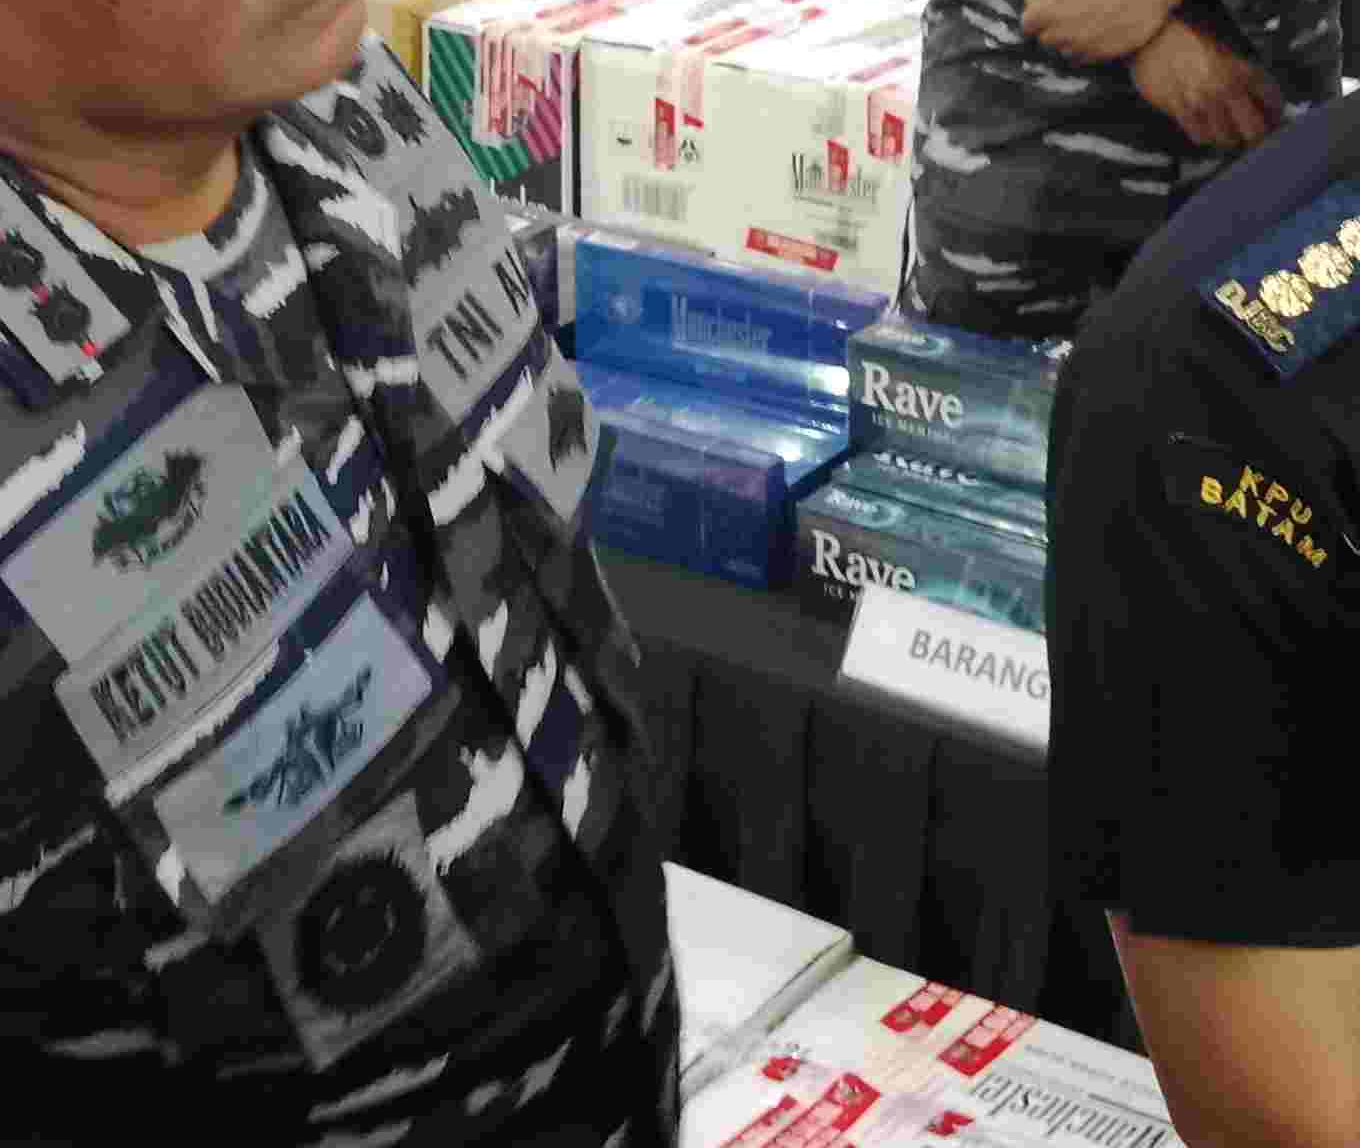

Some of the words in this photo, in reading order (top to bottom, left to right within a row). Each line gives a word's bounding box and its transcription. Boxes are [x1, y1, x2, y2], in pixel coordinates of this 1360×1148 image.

[425, 285, 504, 382] TNI
[860, 359, 964, 429] Rave
[1200, 474, 1328, 568] BATAM
[1238, 464, 1313, 525] KPU
[810, 528, 917, 594] Rave
[907, 628, 1050, 702] BARANG
